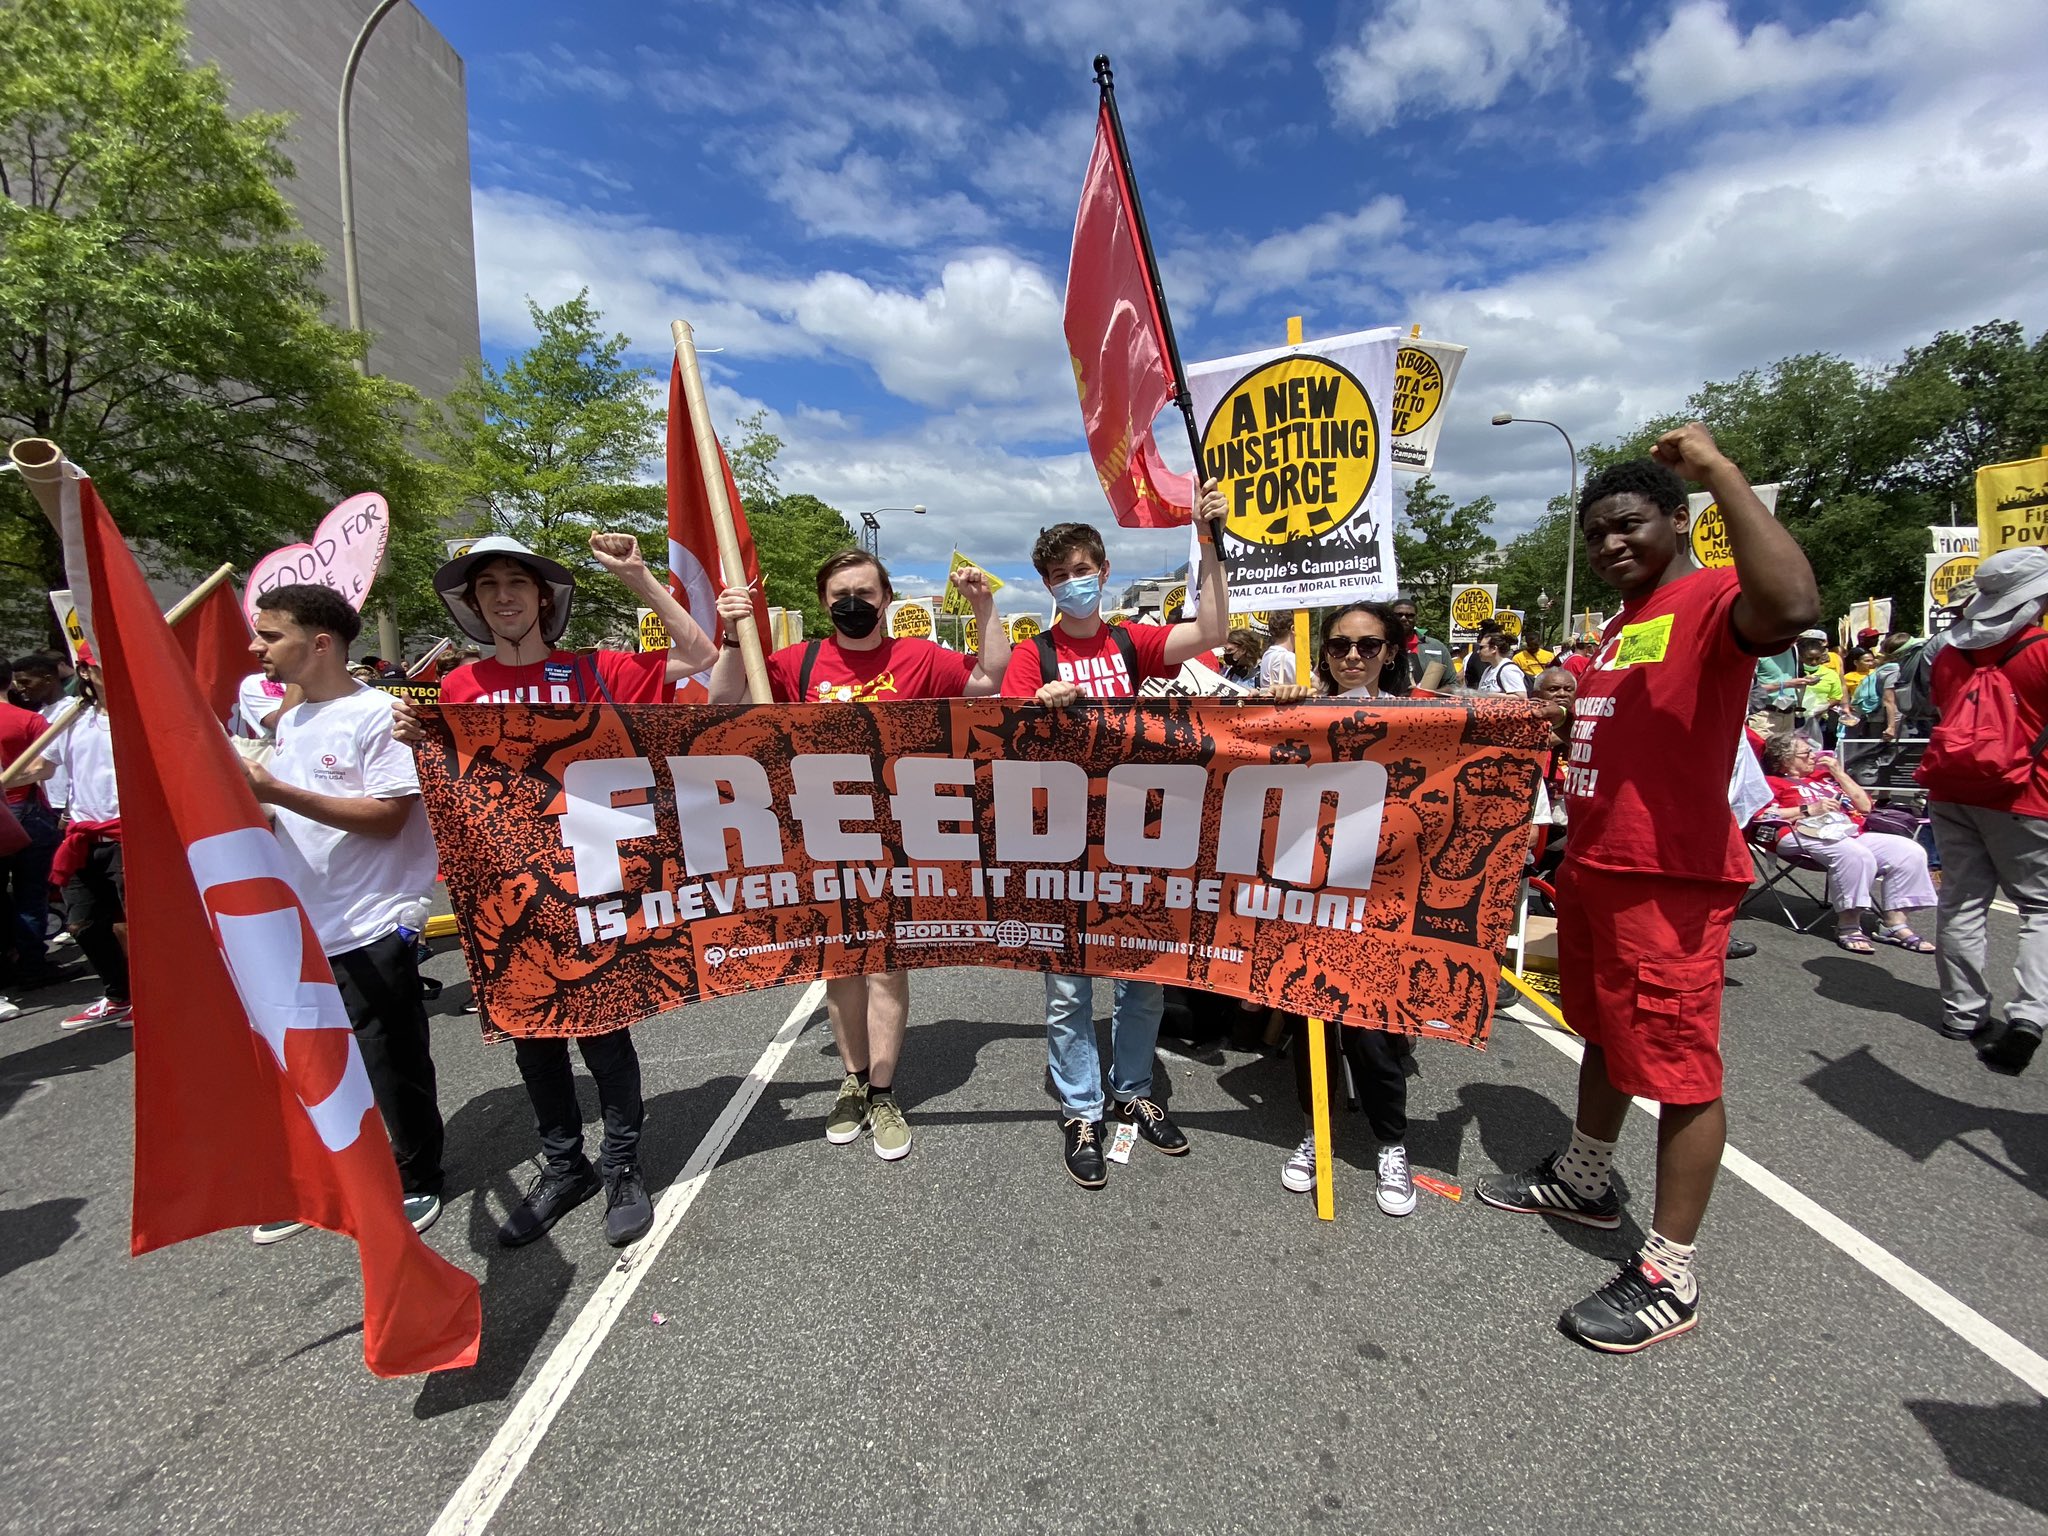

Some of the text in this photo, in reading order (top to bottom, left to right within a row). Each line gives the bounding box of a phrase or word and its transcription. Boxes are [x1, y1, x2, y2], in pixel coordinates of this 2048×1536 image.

[1397, 352, 1439, 391] YBODY'S
[1394, 375, 1420, 395] OT A
[1231, 376, 1341, 439] A NEW
[1409, 396, 1425, 413] TO
[1206, 419, 1368, 483] UNSETTLING
[1393, 449, 1426, 460] Campaign
[1234, 461, 1338, 518] FORCE
[2025, 508, 2048, 524] Fig
[258, 539, 336, 594] FOOD
[341, 504, 382, 545] FOR
[1940, 538, 1979, 553] FLORID
[1236, 562, 1298, 582] People's
[1301, 555, 1377, 575] Campaign
[1943, 566, 1954, 576] WE
[1957, 565, 1971, 576] ARE
[1227, 587, 1252, 598] ONAL
[1254, 585, 1280, 596] CALL
[1282, 583, 1296, 594] for
[1299, 579, 1338, 592] MORAL
[1340, 574, 1384, 588] REVIVAL
[1934, 577, 1952, 591] 140
[1455, 604, 1489, 613] NUEVA
[1457, 596, 1490, 605] FUERZA
[651, 616, 664, 627] NE
[893, 621, 932, 632] DEVASTATION
[895, 614, 929, 624] ECOLOGICAL
[646, 636, 668, 647] FORCE
[1058, 653, 1127, 682] BUILD
[375, 686, 442, 697] VERYBO
[1078, 673, 1131, 697] NITY
[1575, 697, 1616, 717] ORKERS
[558, 754, 1388, 898] FREEDOM
[575, 867, 1366, 946] IS NEVER GIVEN. IT MUST BE WON!
[895, 924, 975, 939] PEOPLE'S
[728, 929, 886, 959] Communist Party USA
[1077, 932, 1244, 963] YOUNG COMMUNIST LEAGUE
